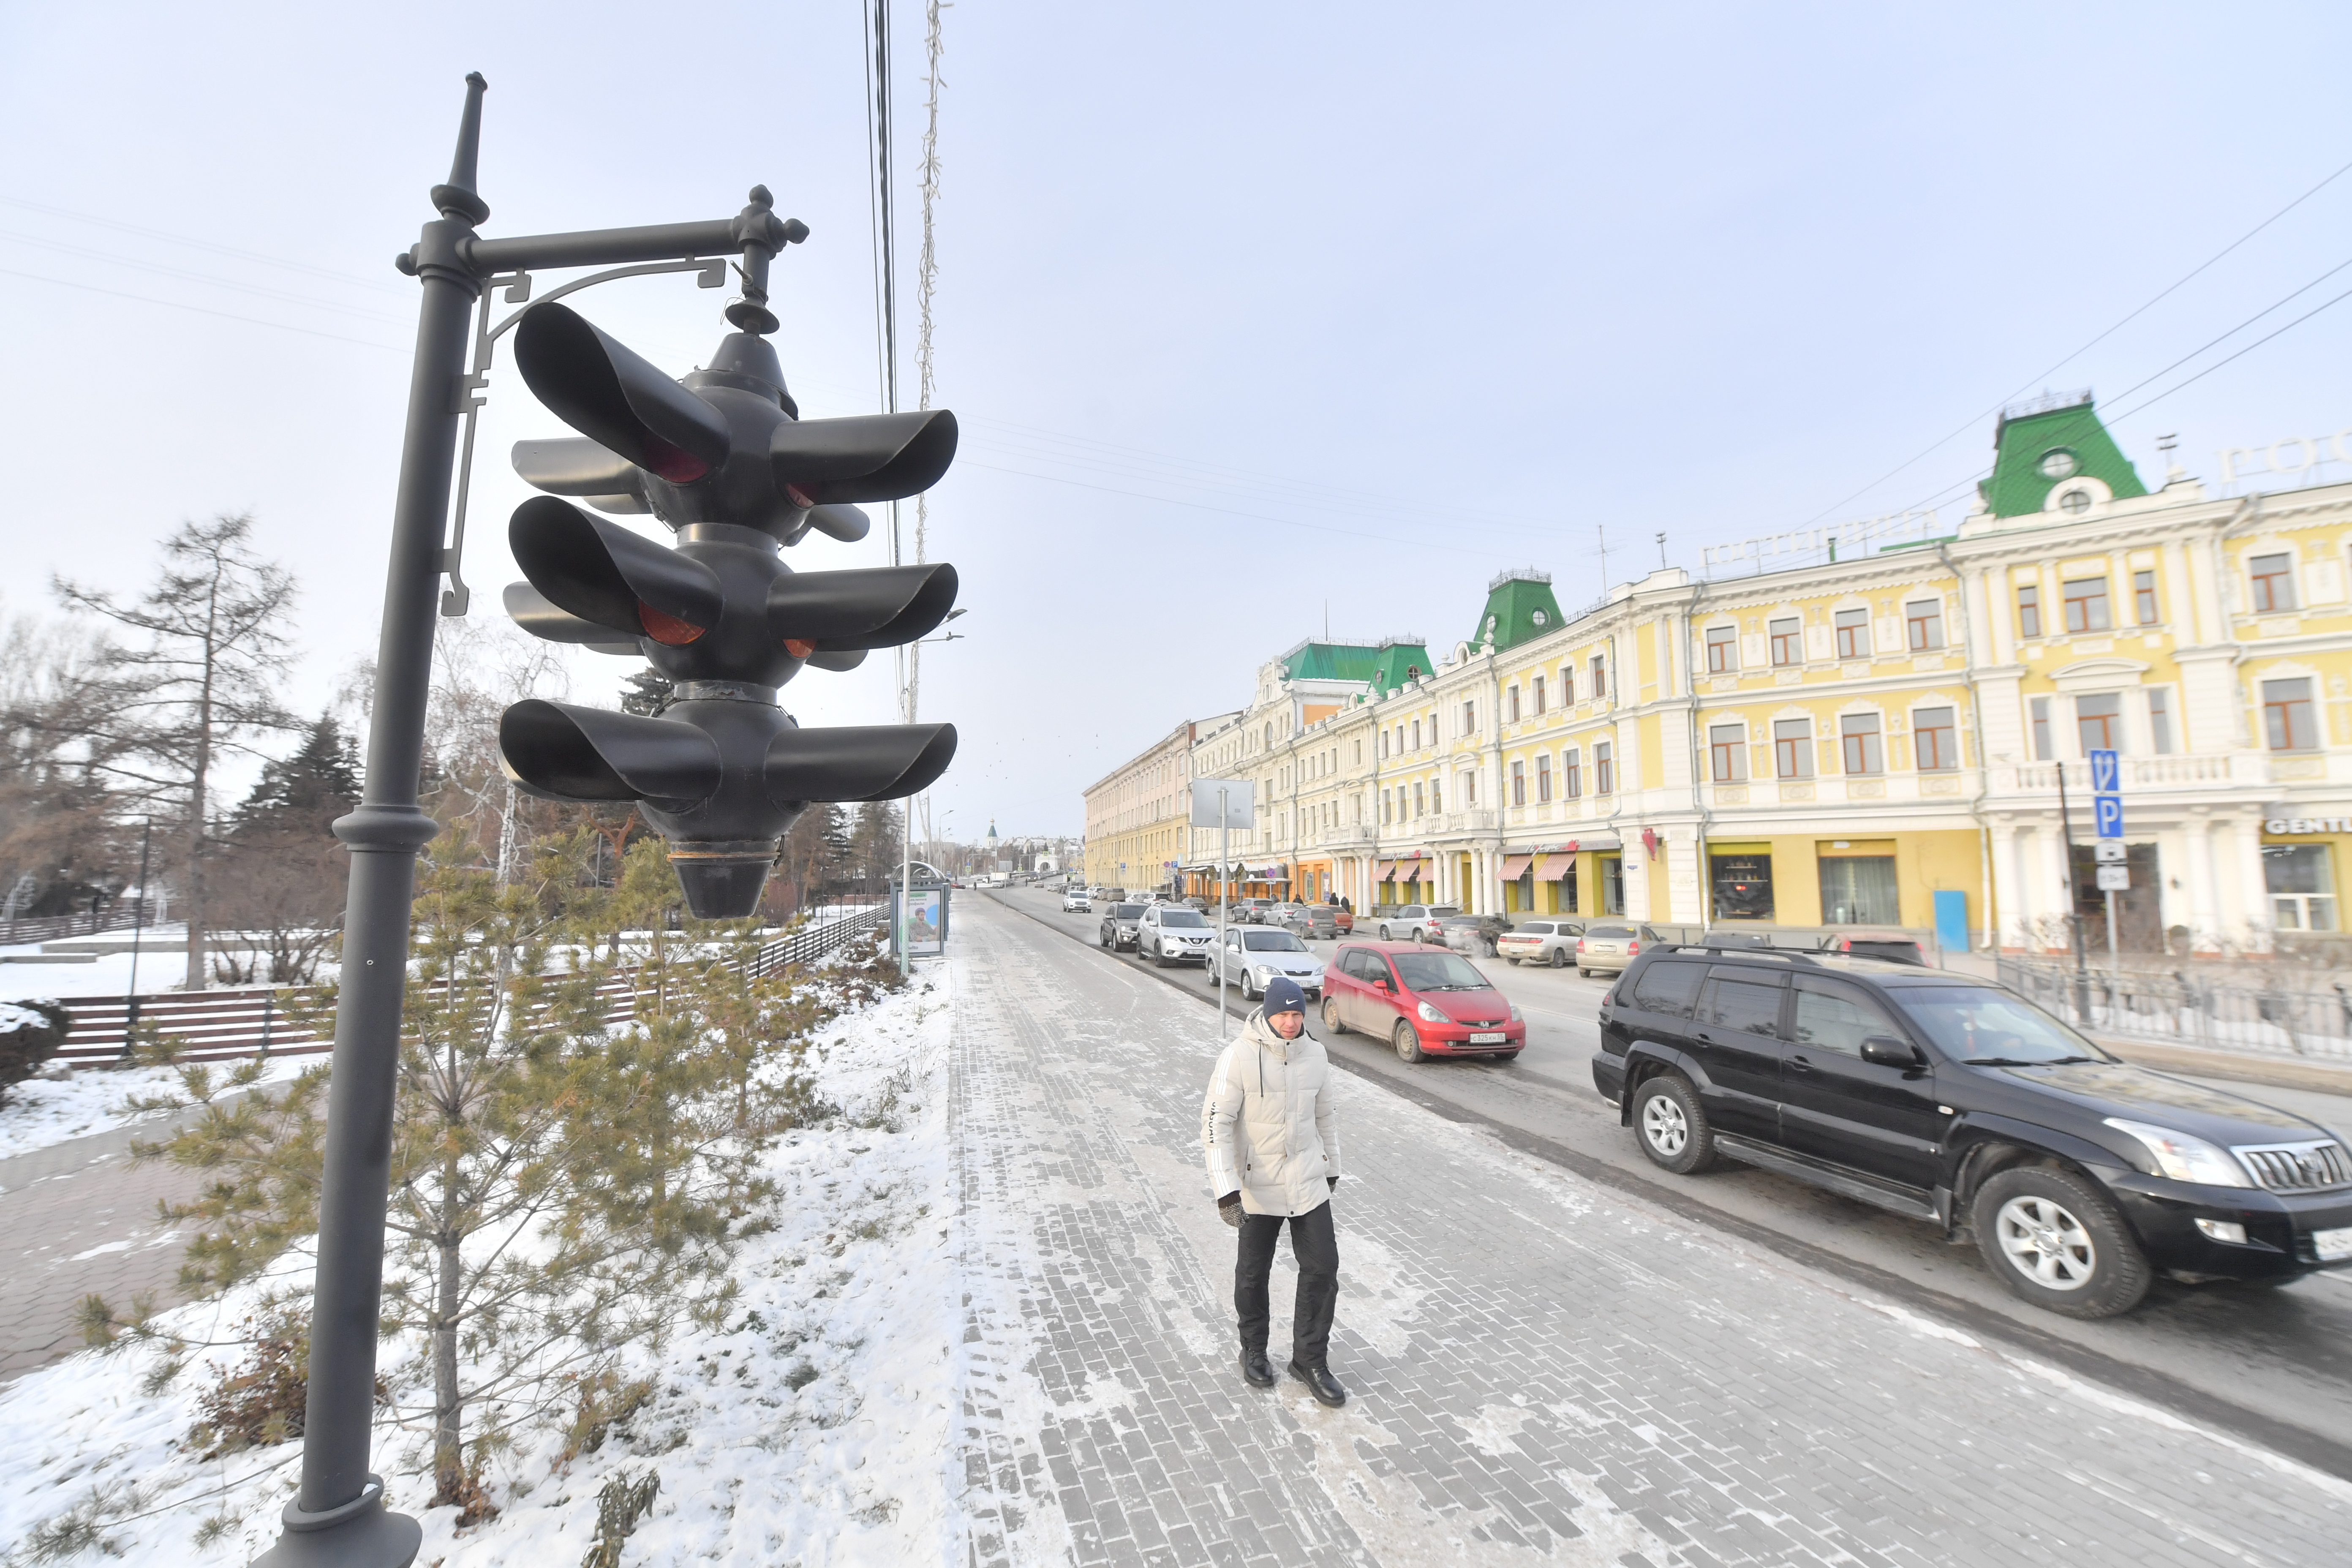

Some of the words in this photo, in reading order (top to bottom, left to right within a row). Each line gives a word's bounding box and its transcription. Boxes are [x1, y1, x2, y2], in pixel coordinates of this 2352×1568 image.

[1698, 507, 1944, 568] ГОСТИНИЦА
[2099, 800, 2119, 834] P
[2265, 817, 2352, 834] GENTL
